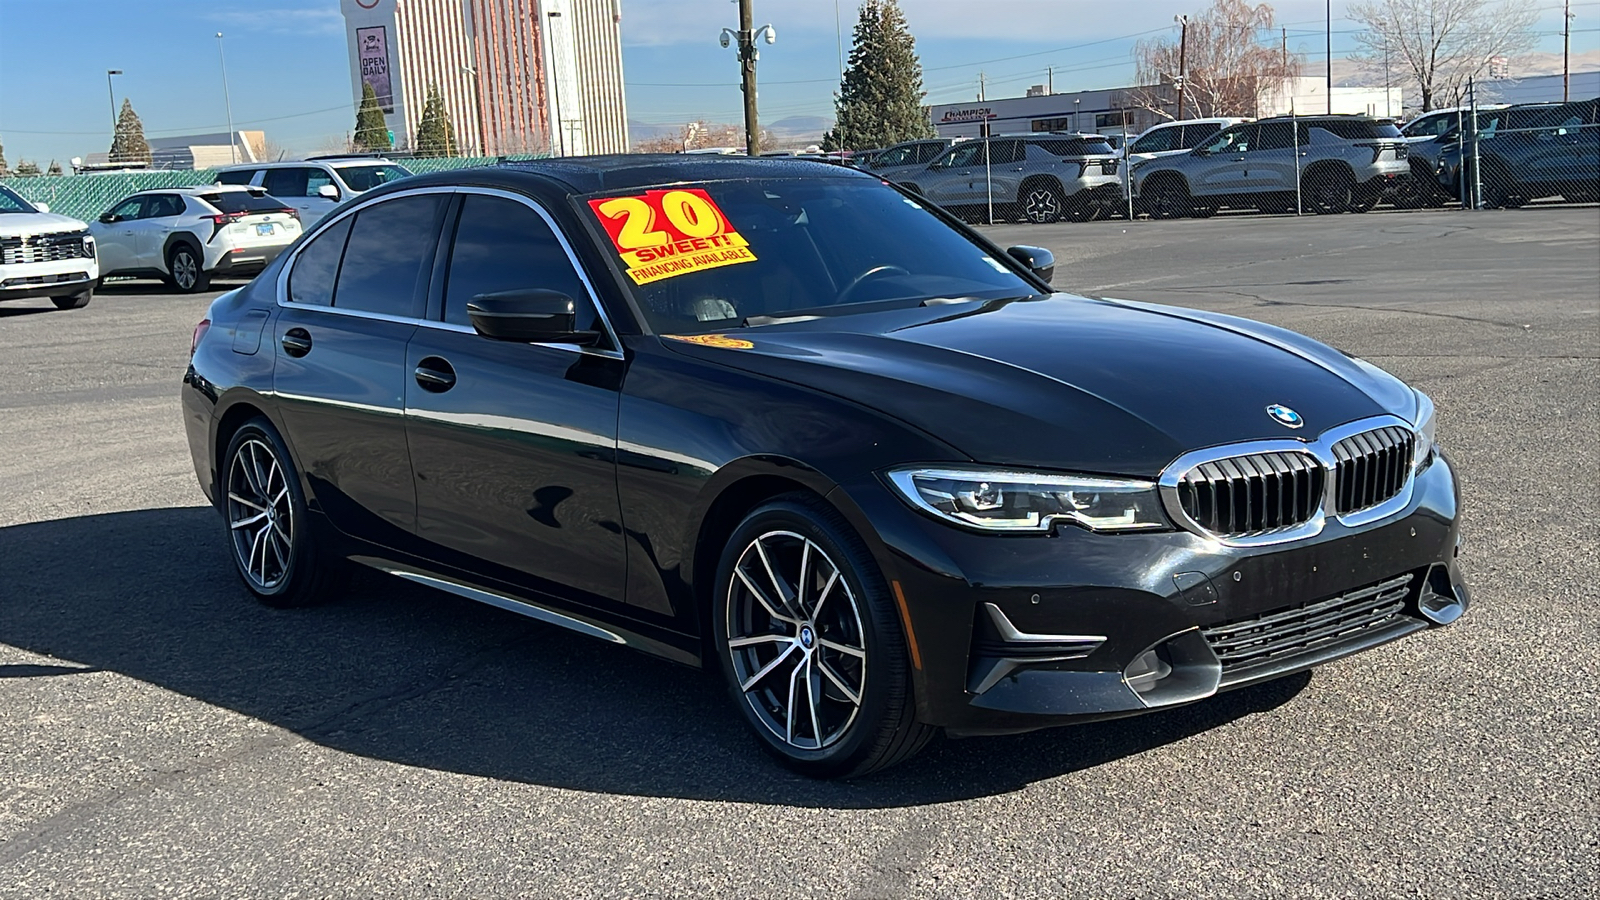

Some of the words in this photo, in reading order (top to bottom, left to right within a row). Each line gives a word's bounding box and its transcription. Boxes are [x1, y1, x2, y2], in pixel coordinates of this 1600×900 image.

[363, 57, 385, 66] OPEN
[363, 66, 386, 75] DAILY
[944, 108, 991, 119] CHAMPION
[598, 191, 725, 249] 20
[635, 235, 733, 262] SWEET!
[631, 258, 691, 280] FINANCING
[693, 248, 750, 267] AVAILABLE
